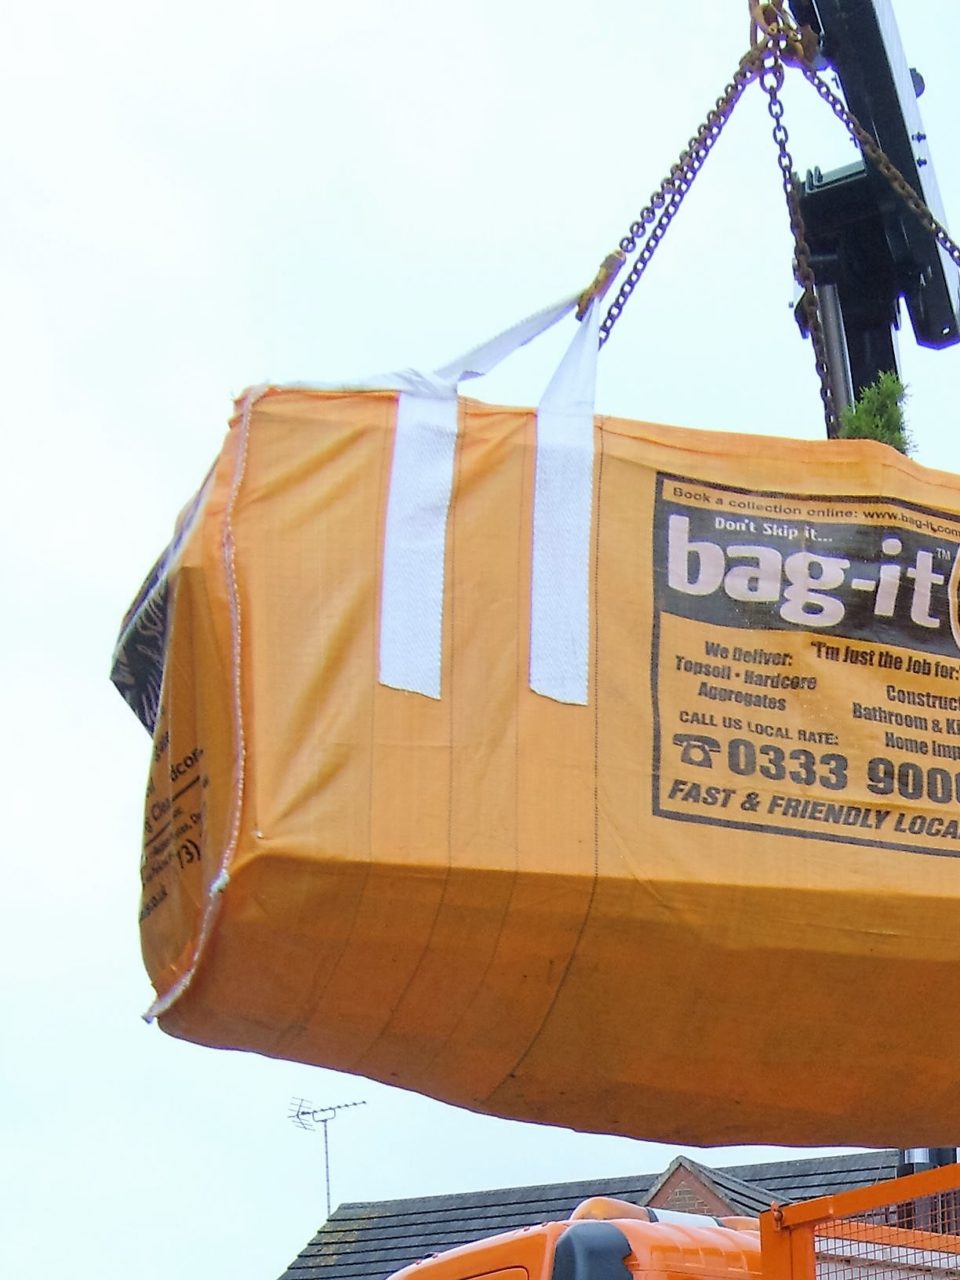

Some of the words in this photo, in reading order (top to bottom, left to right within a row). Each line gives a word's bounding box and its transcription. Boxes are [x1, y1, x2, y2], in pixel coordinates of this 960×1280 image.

[673, 487, 710, 503] Book
[729, 499, 801, 515] collection
[807, 508, 858, 518] online:
[715, 517, 756, 533] Don't
[763, 523, 799, 540] Skip
[805, 526, 833, 542] it...
[668, 514, 944, 628] bag-it
[705, 641, 729, 659] We
[733, 646, 793, 666] Deliver:
[843, 645, 874, 667] Just
[878, 651, 902, 671] the
[906, 656, 931, 676] Job
[675, 655, 731, 680] Topsoil
[744, 670, 817, 690] Hardcore
[698, 682, 786, 711] Aggregates
[679, 710, 718, 727] CALL
[722, 716, 742, 730] US
[748, 721, 793, 740] LOCAL
[798, 729, 839, 746] RATE:
[852, 702, 928, 731] Bathroom
[931, 718, 943, 733] &
[885, 731, 928, 755] Home
[727, 739, 848, 792] 0333
[668, 780, 736, 810] FAST
[740, 791, 762, 813] &
[767, 798, 891, 831] FRIENDLY
